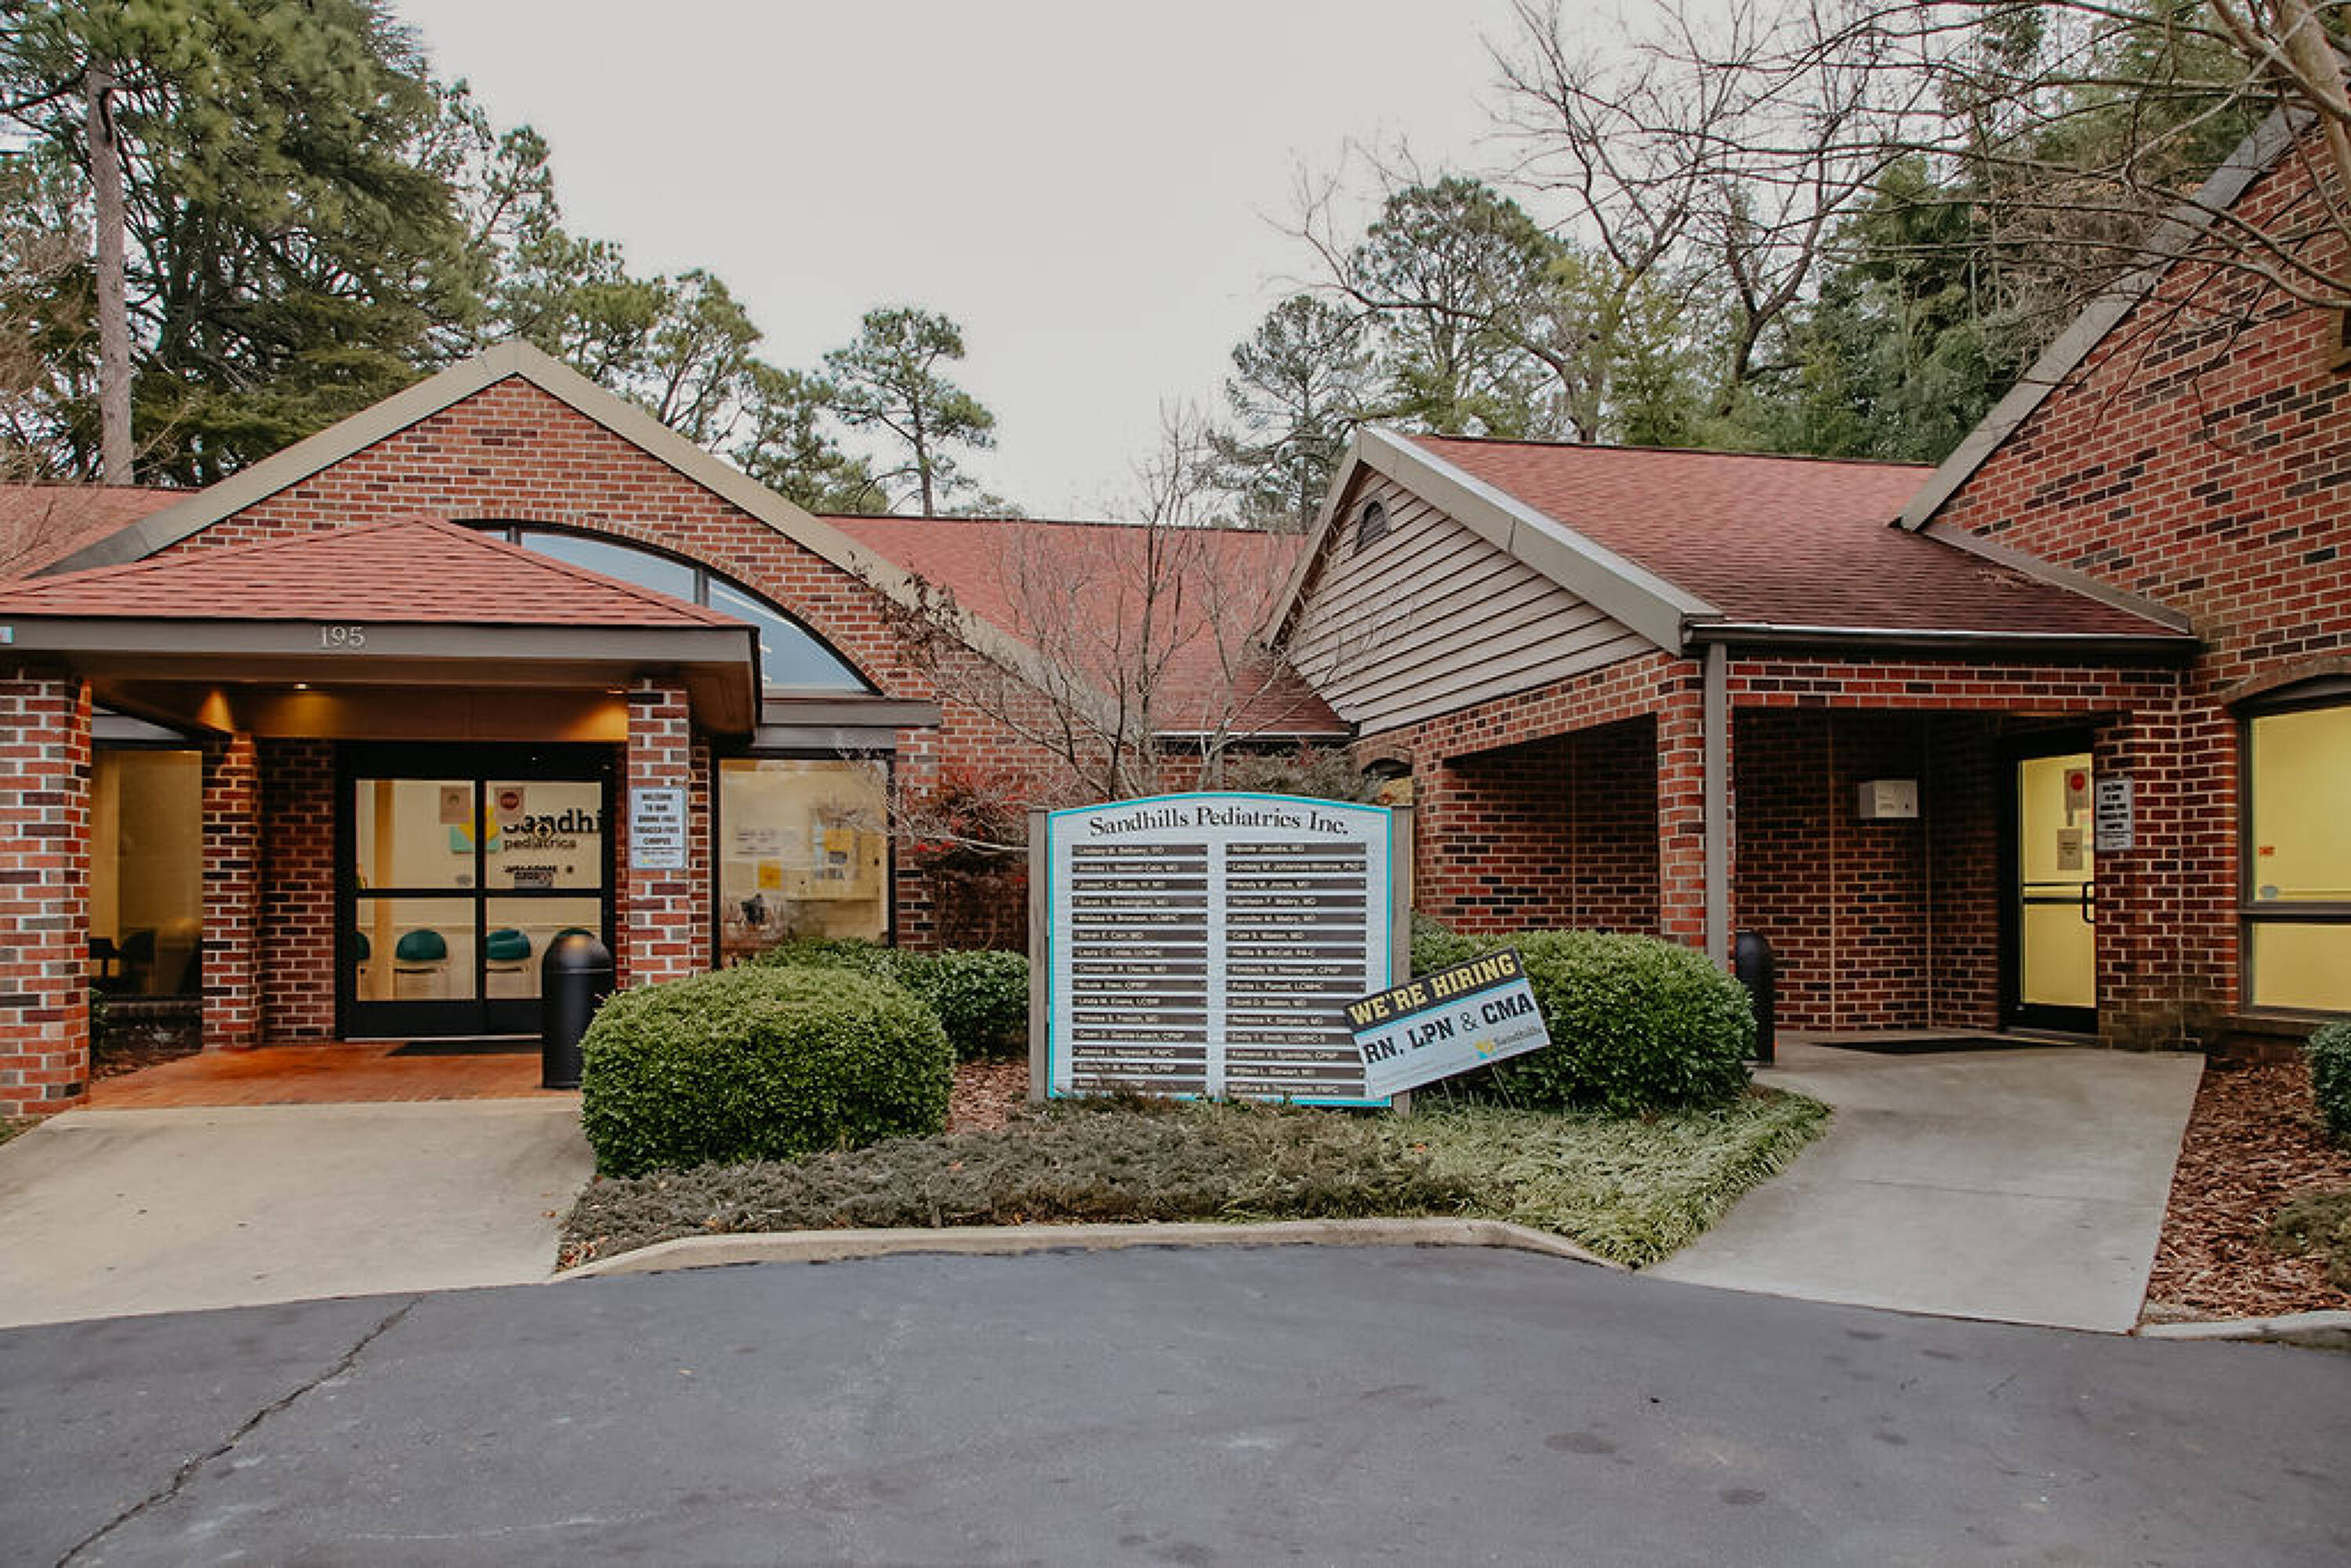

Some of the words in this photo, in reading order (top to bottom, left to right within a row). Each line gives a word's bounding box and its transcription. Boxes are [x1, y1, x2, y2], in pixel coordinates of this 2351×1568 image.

[320, 626, 365, 647] 195
[502, 808, 603, 834] andhi
[1088, 807, 1188, 837] Sandhills
[1195, 806, 1301, 828] Pediatrics
[1308, 810, 1349, 836] Inc.
[503, 836, 577, 851] pediatrics
[1348, 982, 1429, 1025] WE'RE
[1429, 954, 1517, 999] HIRING
[1406, 1016, 1456, 1050] LPN
[1459, 1011, 1479, 1032] &
[1481, 993, 1535, 1025] CMA
